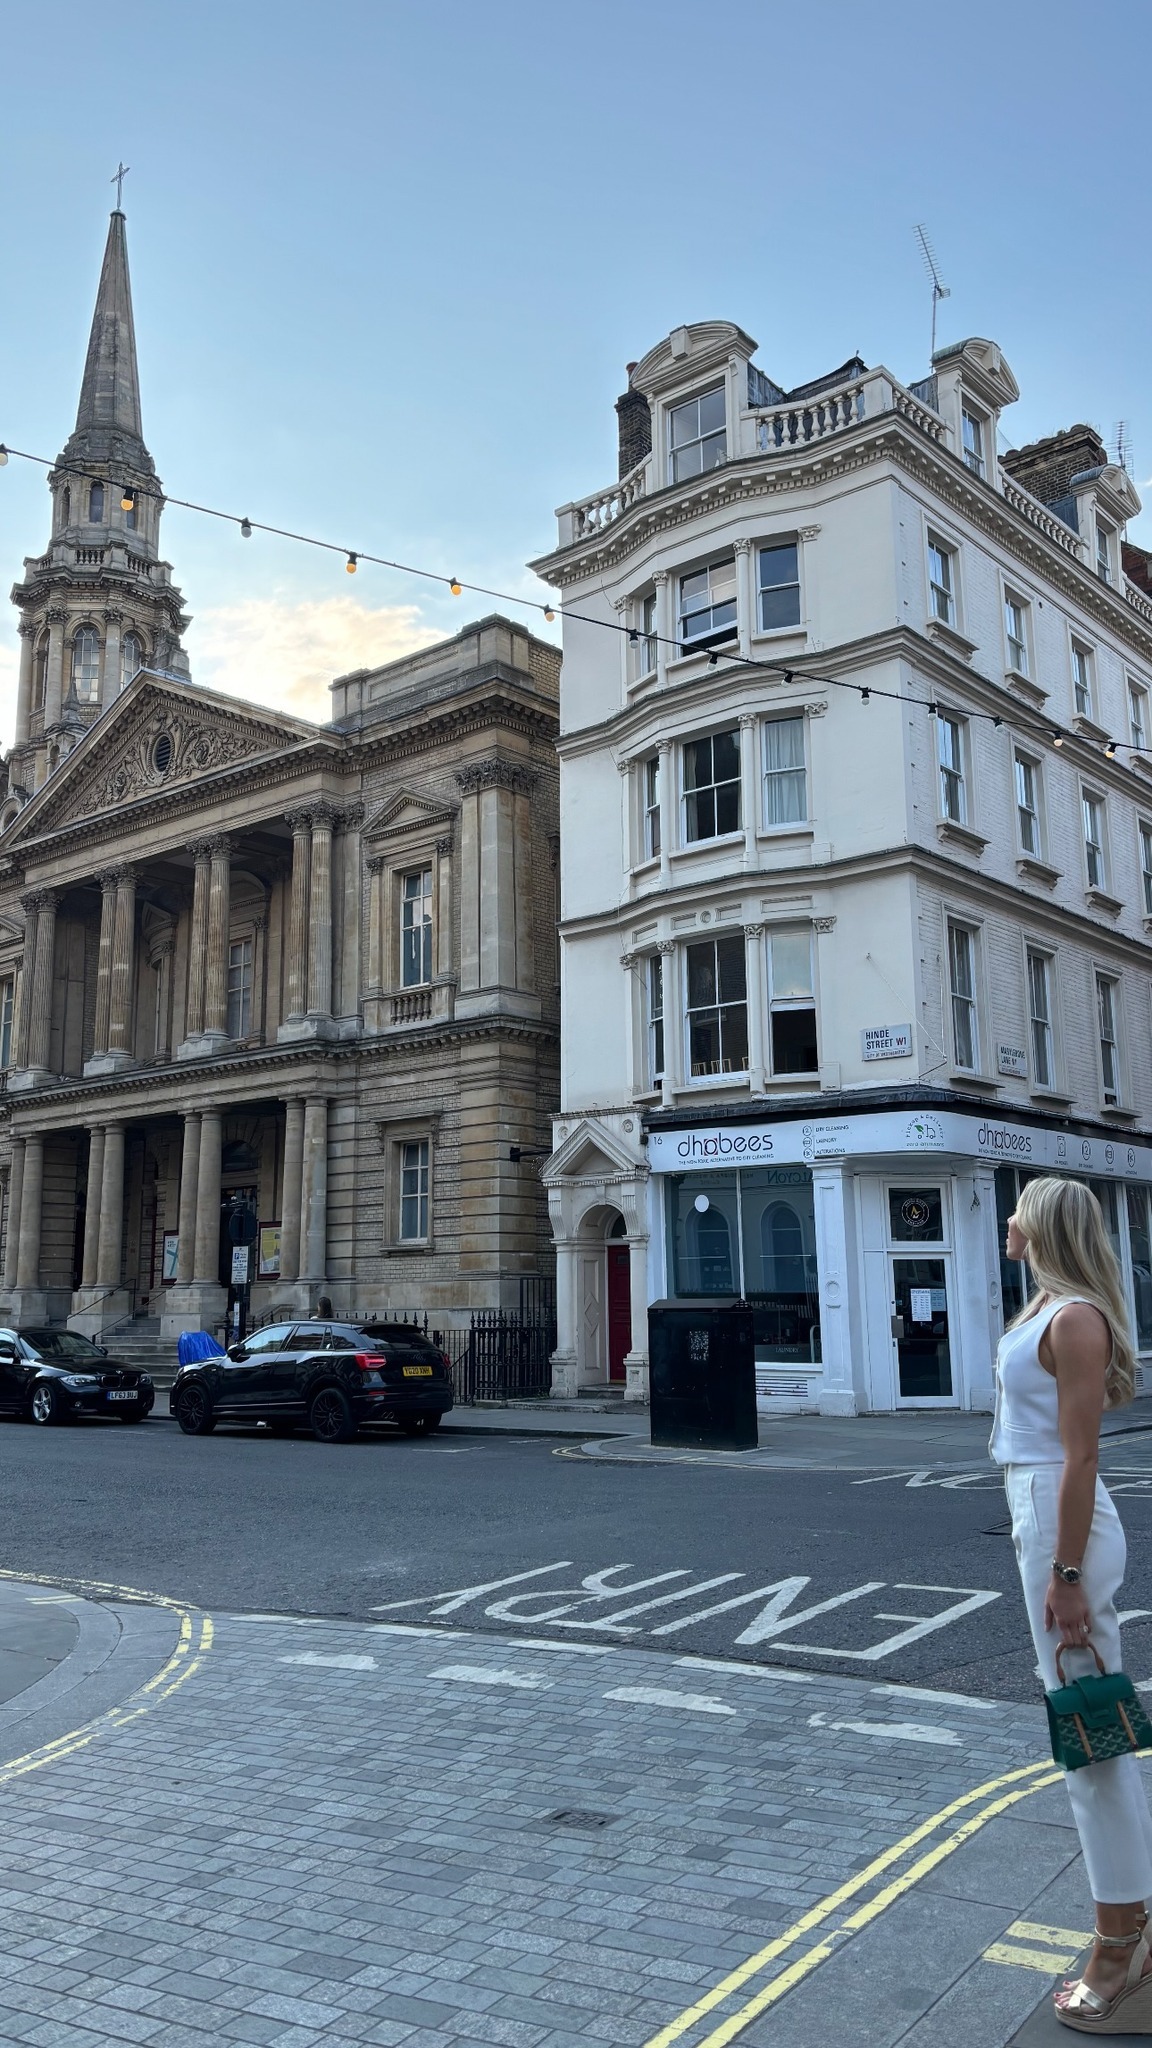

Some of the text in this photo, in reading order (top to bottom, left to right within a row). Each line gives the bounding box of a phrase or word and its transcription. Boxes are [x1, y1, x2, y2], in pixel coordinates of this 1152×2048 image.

[866, 1030, 889, 1040] HINDE
[867, 1037, 906, 1049] STREET W1
[654, 1136, 662, 1145] 16
[369, 1561, 1003, 1660] ENTRY
